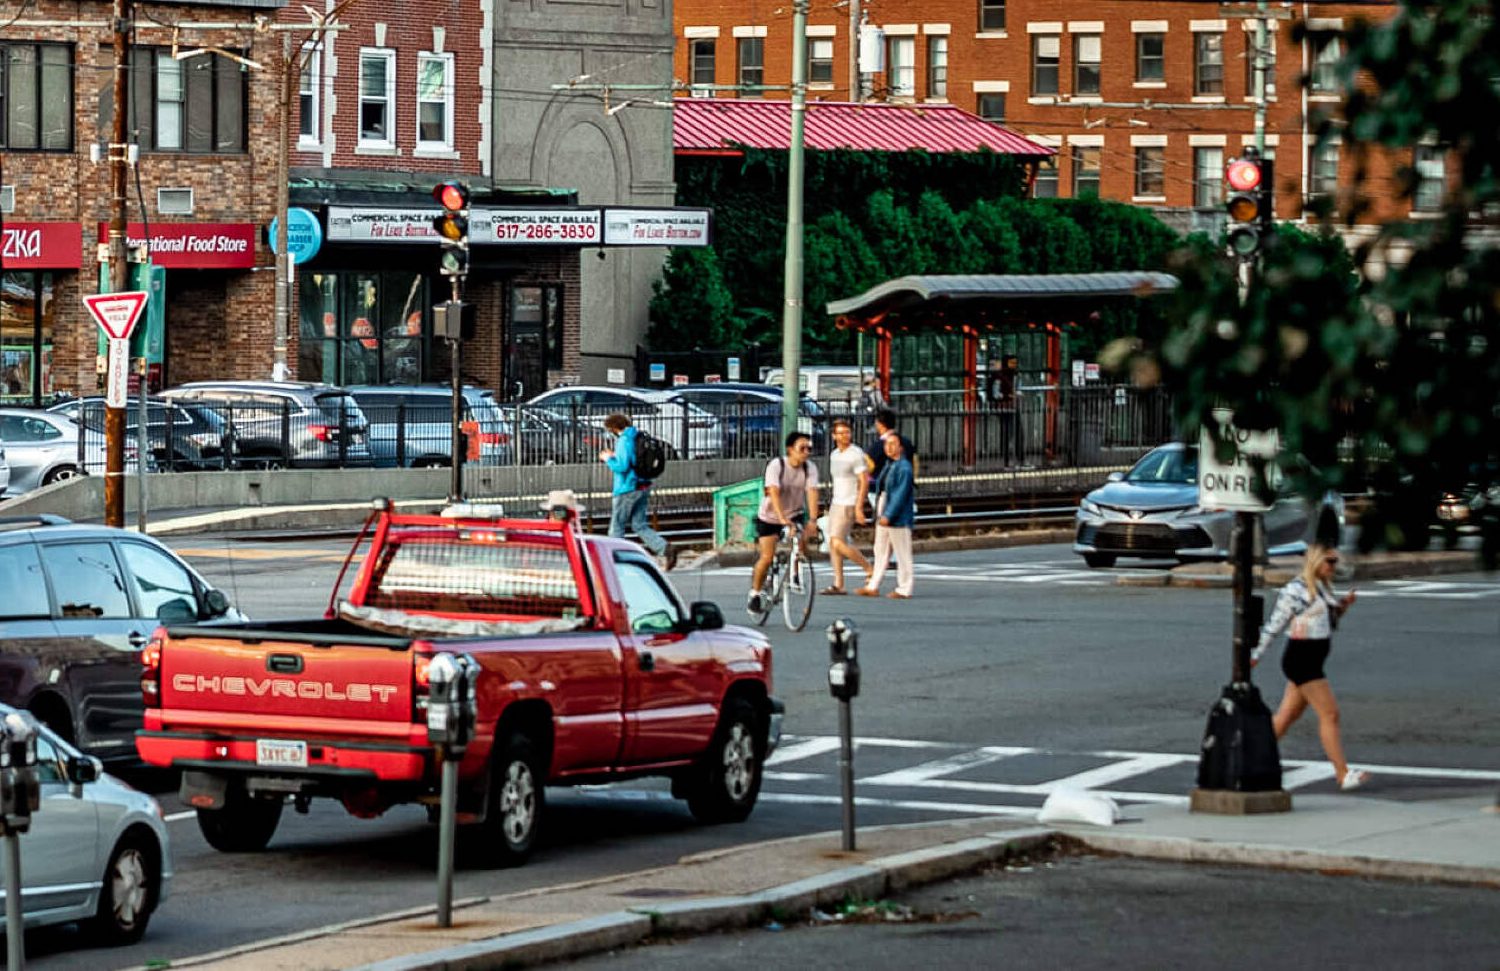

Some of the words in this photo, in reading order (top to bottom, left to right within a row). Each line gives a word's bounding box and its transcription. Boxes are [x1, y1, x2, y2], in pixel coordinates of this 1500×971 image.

[352, 214, 398, 222] COMMERCIAL
[400, 214, 421, 222] SPACE
[492, 216, 537, 224] COMMERCIAL
[539, 216, 560, 224] SPACE
[562, 216, 598, 224] AVAILABLE
[497, 224, 595, 239] 617-286-3830
[186, 236, 216, 252] Food
[216, 236, 248, 252] Store
[1204, 473, 1228, 491] ON
[172, 674, 398, 703] CHEVROLET
